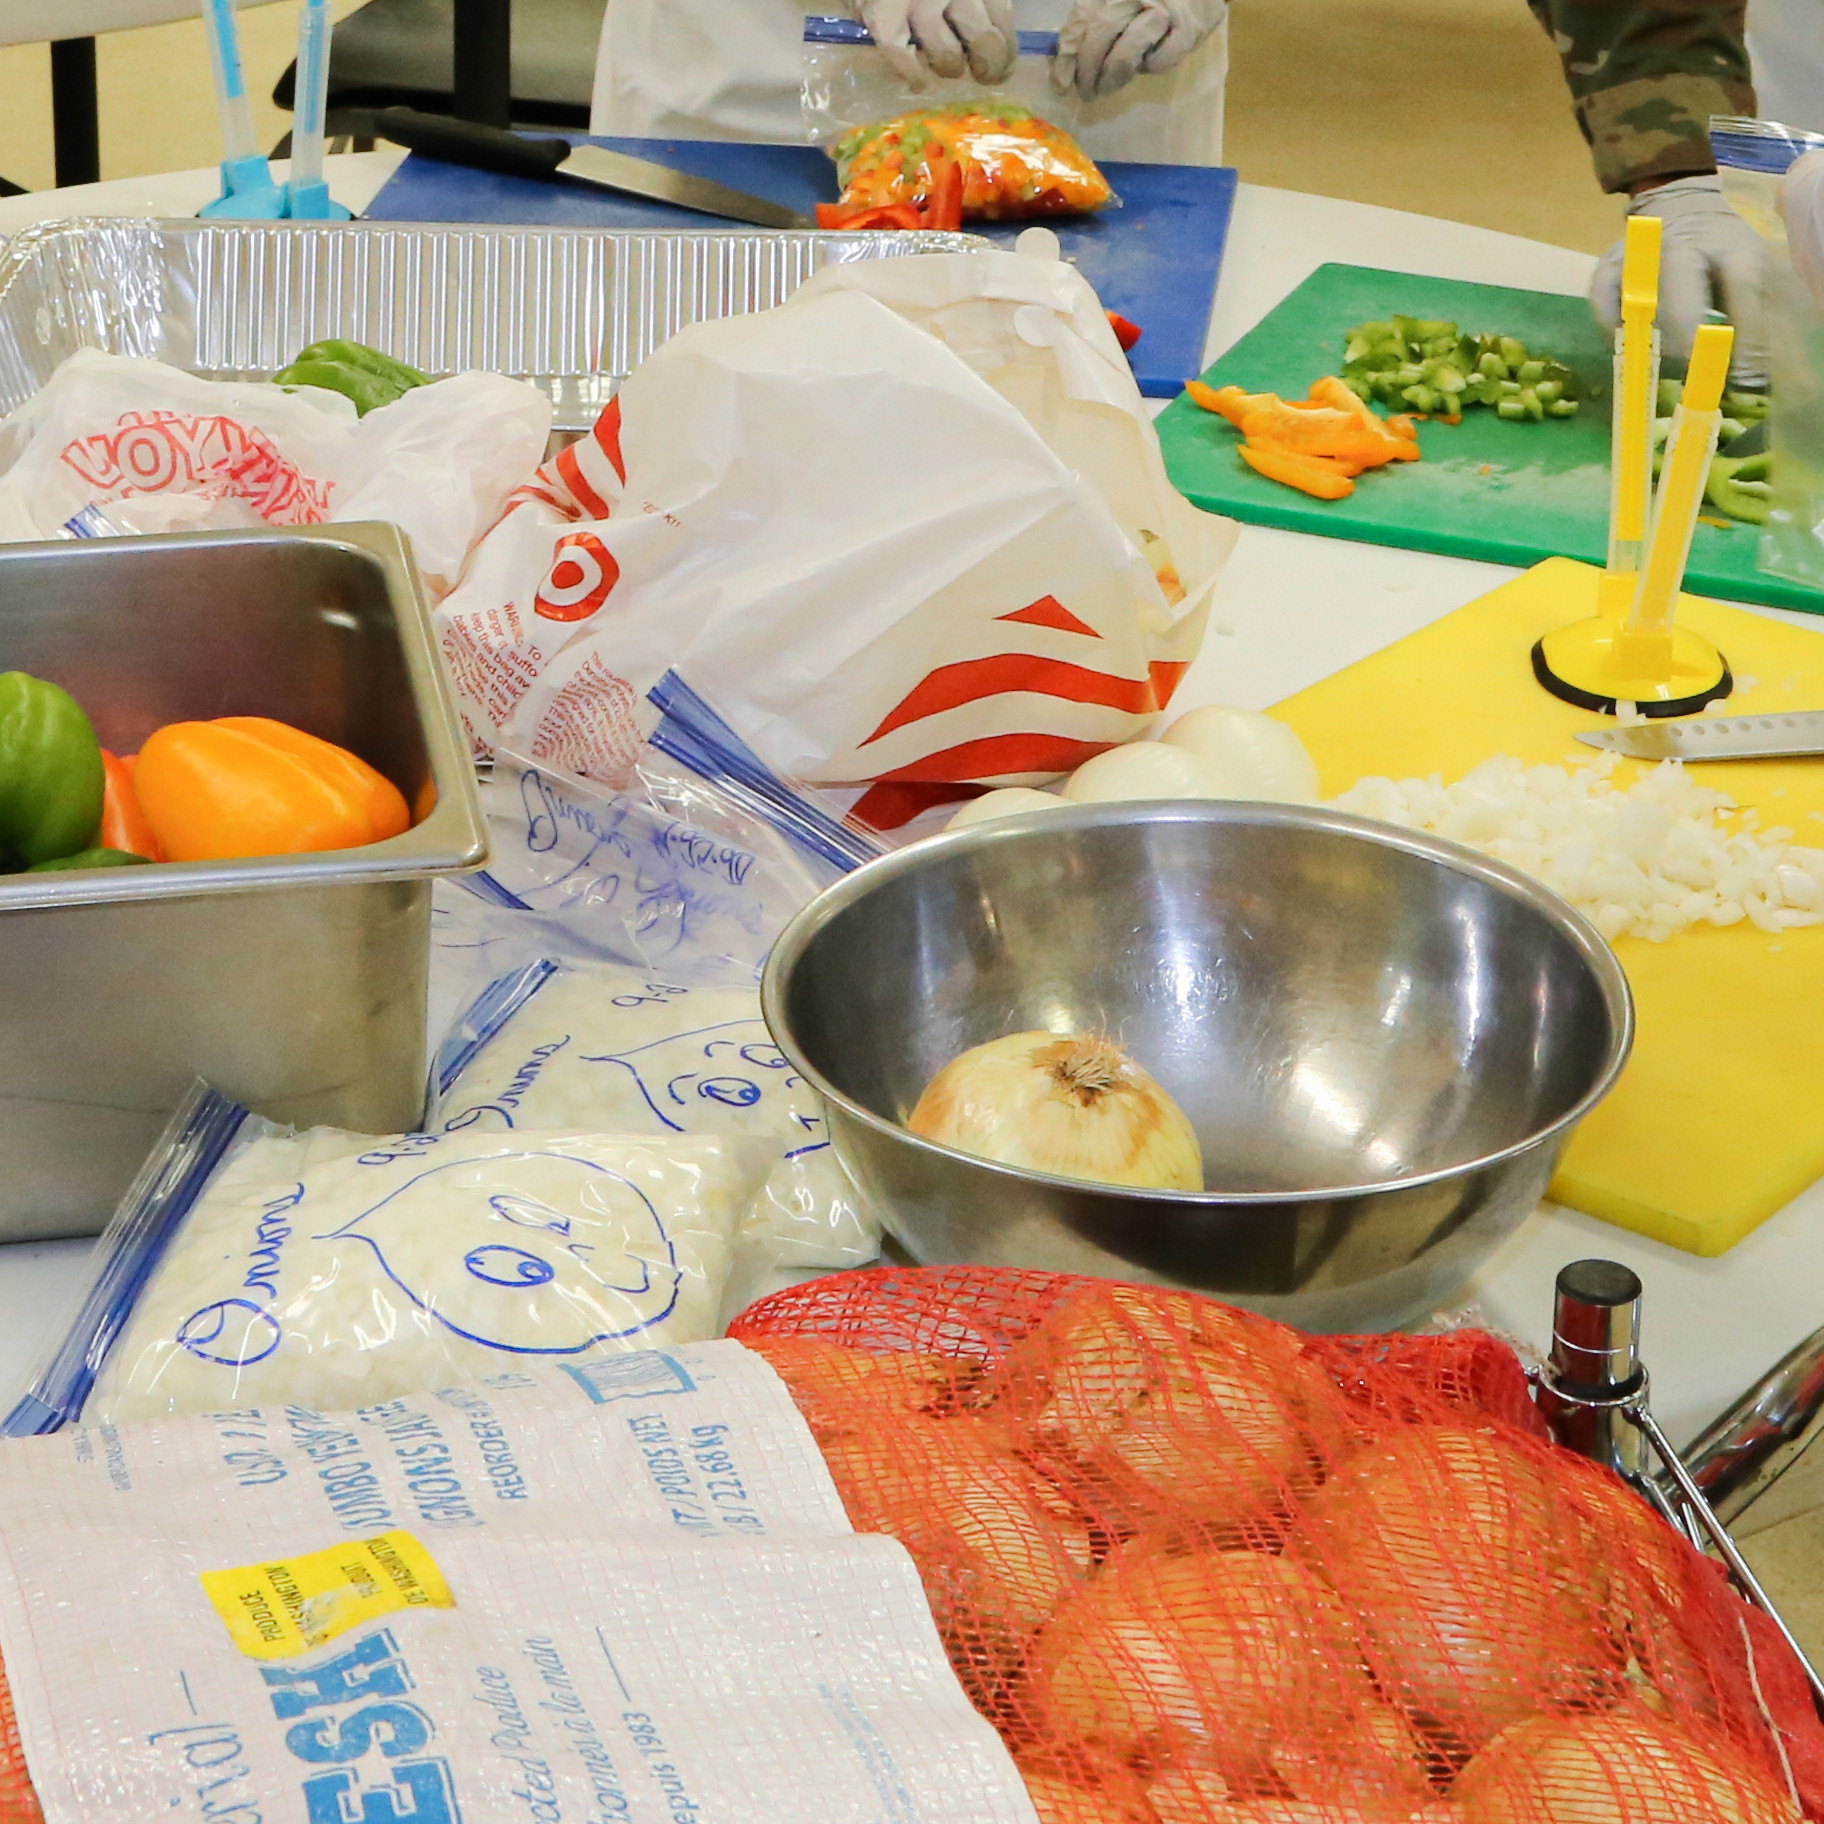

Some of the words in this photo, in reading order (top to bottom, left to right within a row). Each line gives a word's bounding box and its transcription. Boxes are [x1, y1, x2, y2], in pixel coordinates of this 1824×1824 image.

[477, 652, 497, 675] and
[177, 1181, 305, 1366] Onions
[626, 1413, 673, 1444] NET
[687, 1424, 729, 1449] kg
[468, 1419, 529, 1500] REORDER
[641, 1447, 697, 1497] POIDS
[694, 1450, 747, 1501] 22.68
[340, 1561, 383, 1600] PRODUIT
[362, 1537, 420, 1592] WASHINGTON
[239, 1589, 286, 1642] PRODUCE
[521, 1635, 575, 1690] main
[472, 1666, 539, 1753] Produce
[539, 1692, 587, 1715] la
[621, 1712, 667, 1758] 1983
